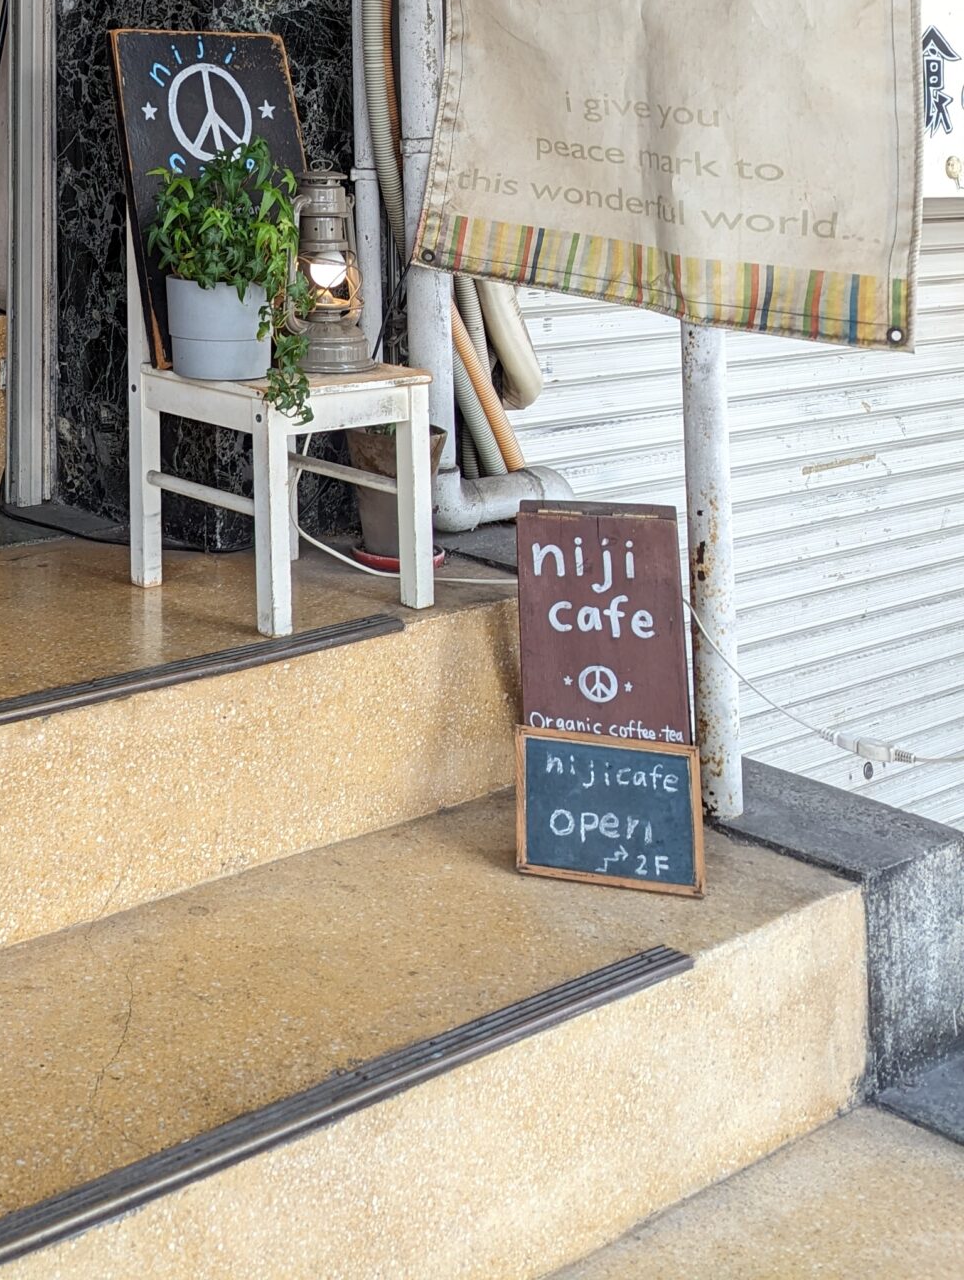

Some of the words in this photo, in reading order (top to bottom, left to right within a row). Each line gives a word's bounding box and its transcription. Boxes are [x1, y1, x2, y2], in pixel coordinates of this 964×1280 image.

[149, 35, 237, 87] niji
[565, 90, 573, 113] i
[583, 94, 651, 123] give
[654, 101, 720, 130] you
[536, 136, 625, 165] peace
[639, 144, 720, 178] mark
[735, 158, 785, 182] to
[457, 167, 519, 195] this
[530, 181, 685, 226] wonderful
[531, 536, 636, 594] niji
[548, 595, 656, 639] cafe
[529, 711, 603, 735] Organic
